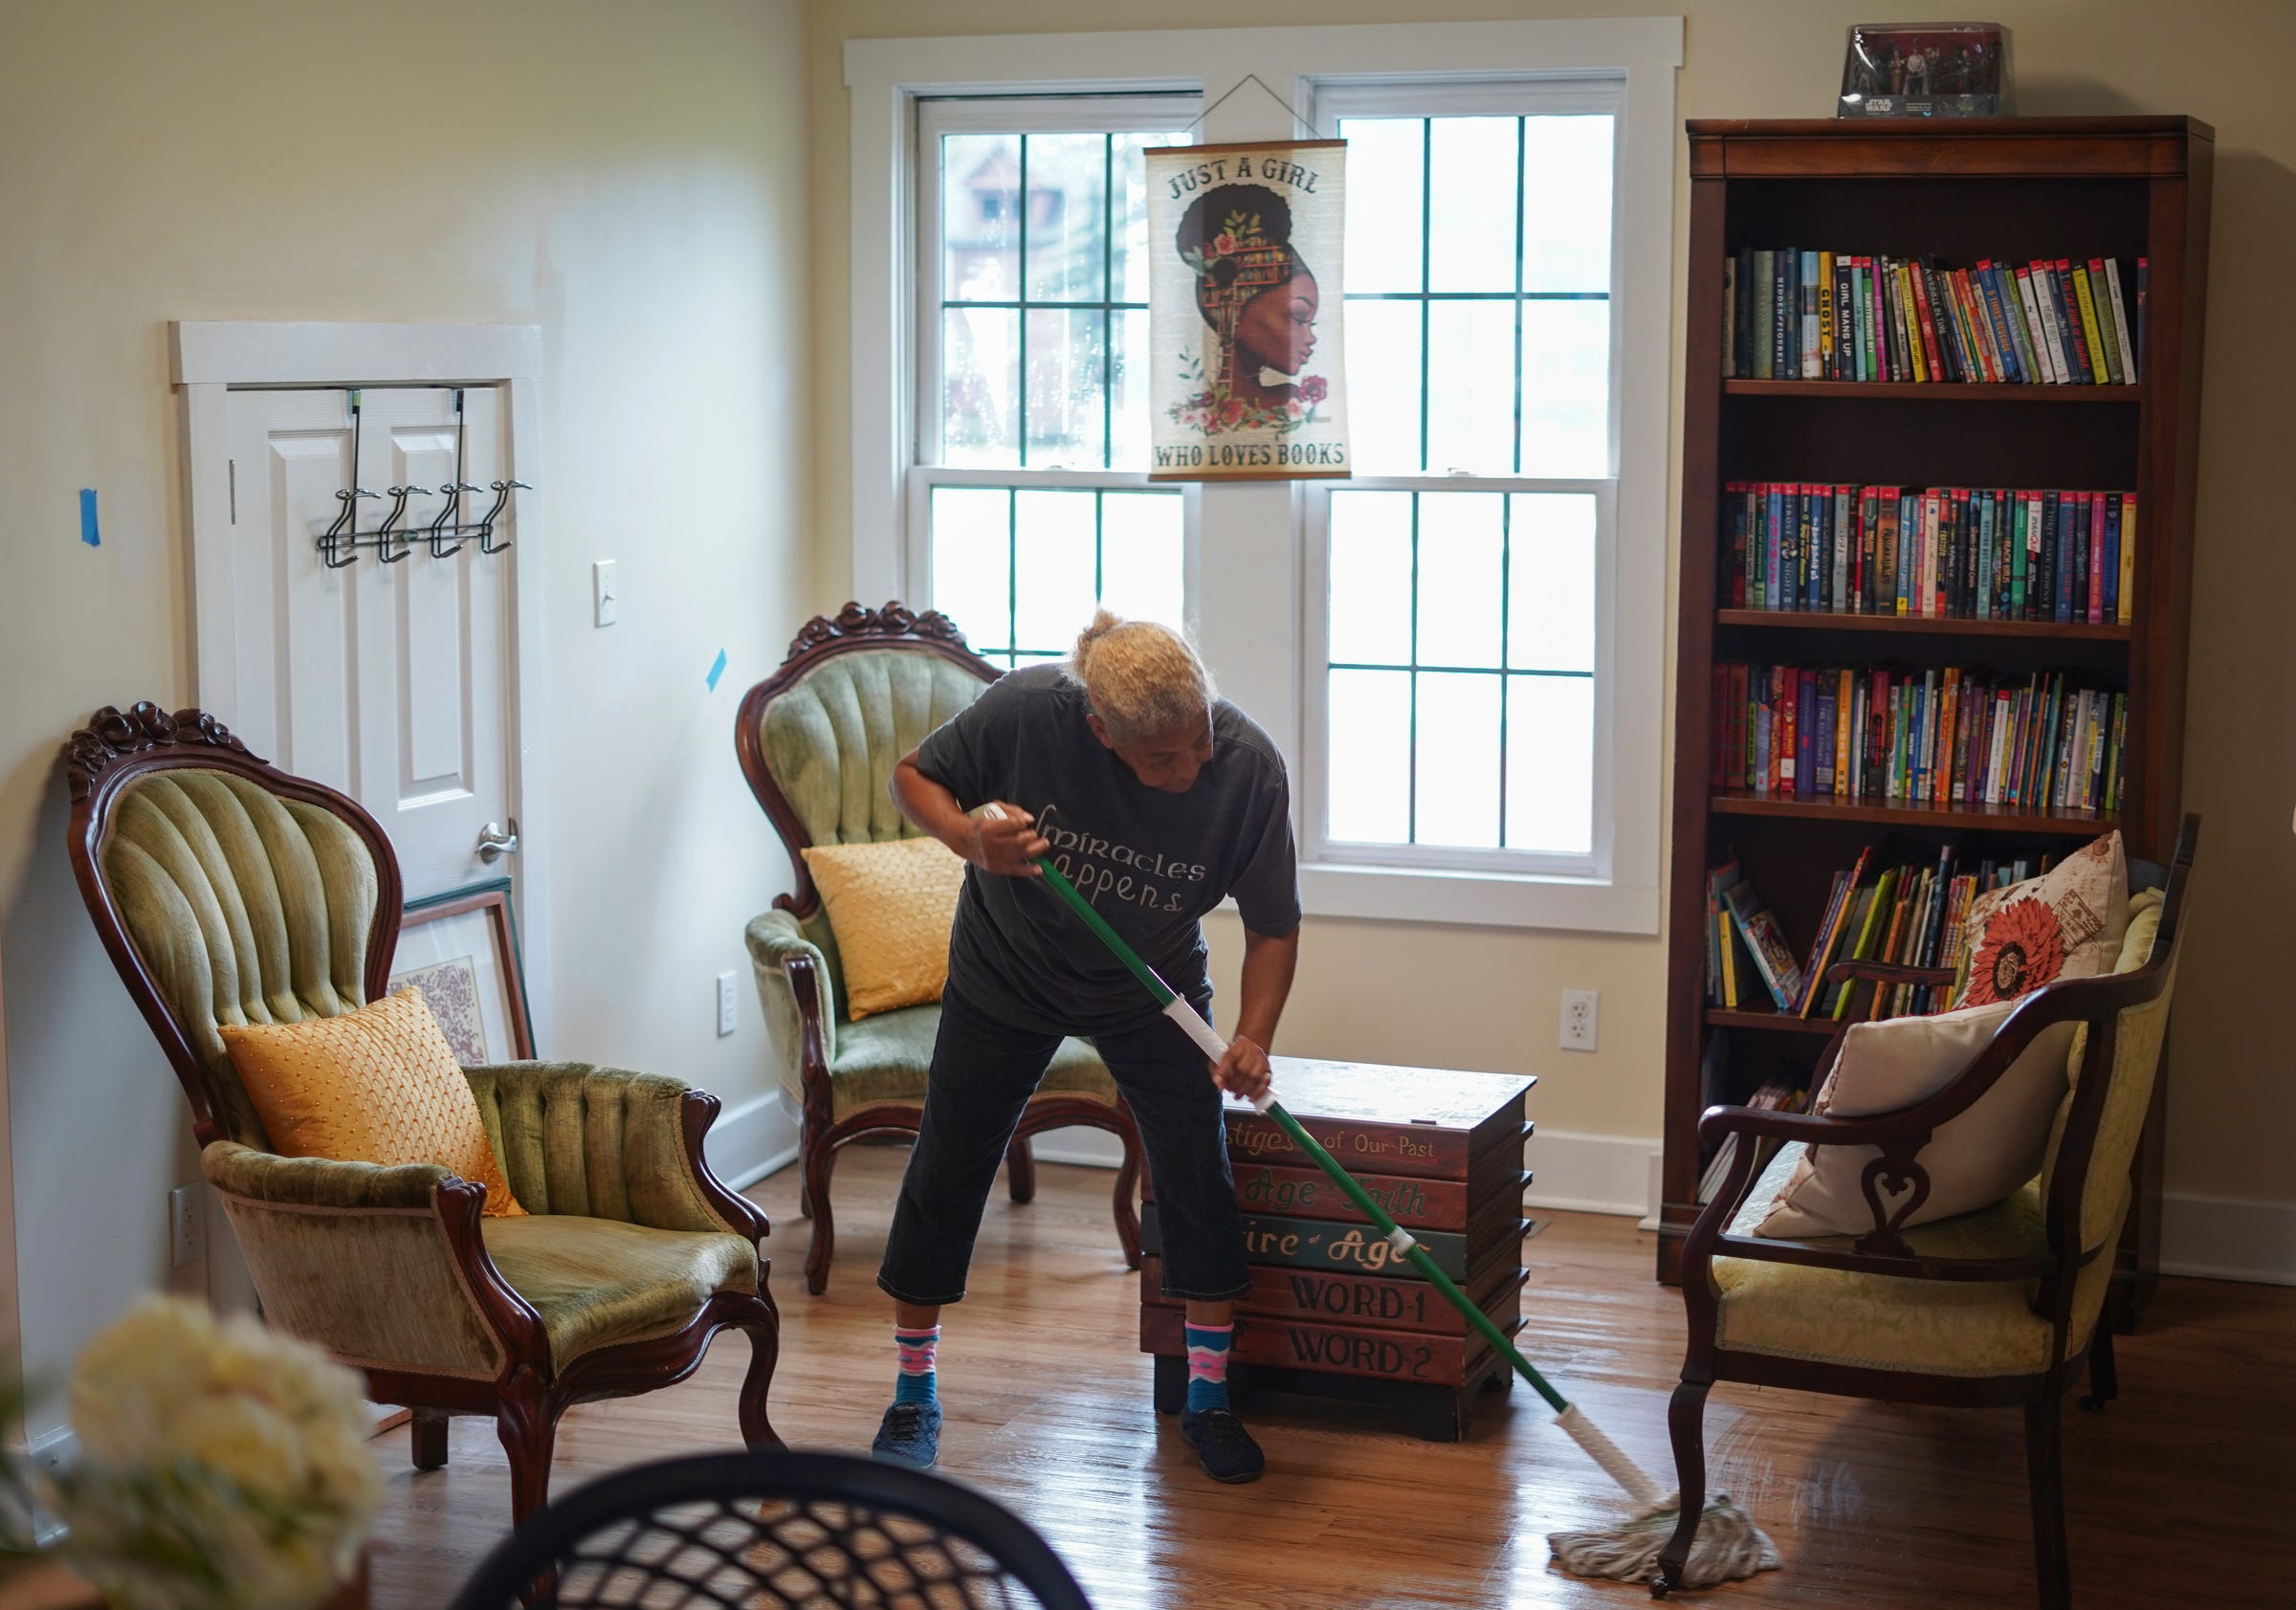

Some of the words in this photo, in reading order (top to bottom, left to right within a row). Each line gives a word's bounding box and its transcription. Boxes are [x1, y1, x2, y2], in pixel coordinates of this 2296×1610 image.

[1167, 159, 1227, 200] JUST
[1236, 157, 1253, 178] A
[1261, 158, 1320, 194] GIRL
[1840, 282, 1849, 306] GIRL
[2064, 291, 2077, 307] CAT
[1821, 289, 1830, 338] GHOST
[1841, 309, 1851, 340] MANS
[1843, 342, 1852, 357] UP
[1155, 445, 1203, 467] WHO
[1207, 444, 1271, 466] LOVES
[1277, 443, 1344, 466] BOOKS
[2045, 509, 2055, 536] THREE
[2002, 540, 2011, 562] BLACK
[2043, 539, 2053, 563] DARK
[2041, 564, 2052, 602] CROWNS
[1225, 1121, 1294, 1157] stiges
[1323, 1131, 1345, 1149] of
[1355, 1134, 1388, 1153] Our
[1399, 1136, 1435, 1158] Past
[1245, 1167, 1317, 1212] Age
[1244, 1220, 1299, 1256] ire
[1328, 1227, 1431, 1270] Age
[1288, 1276, 1425, 1323] WORD-1
[1286, 1328, 1432, 1378] WORD-2
